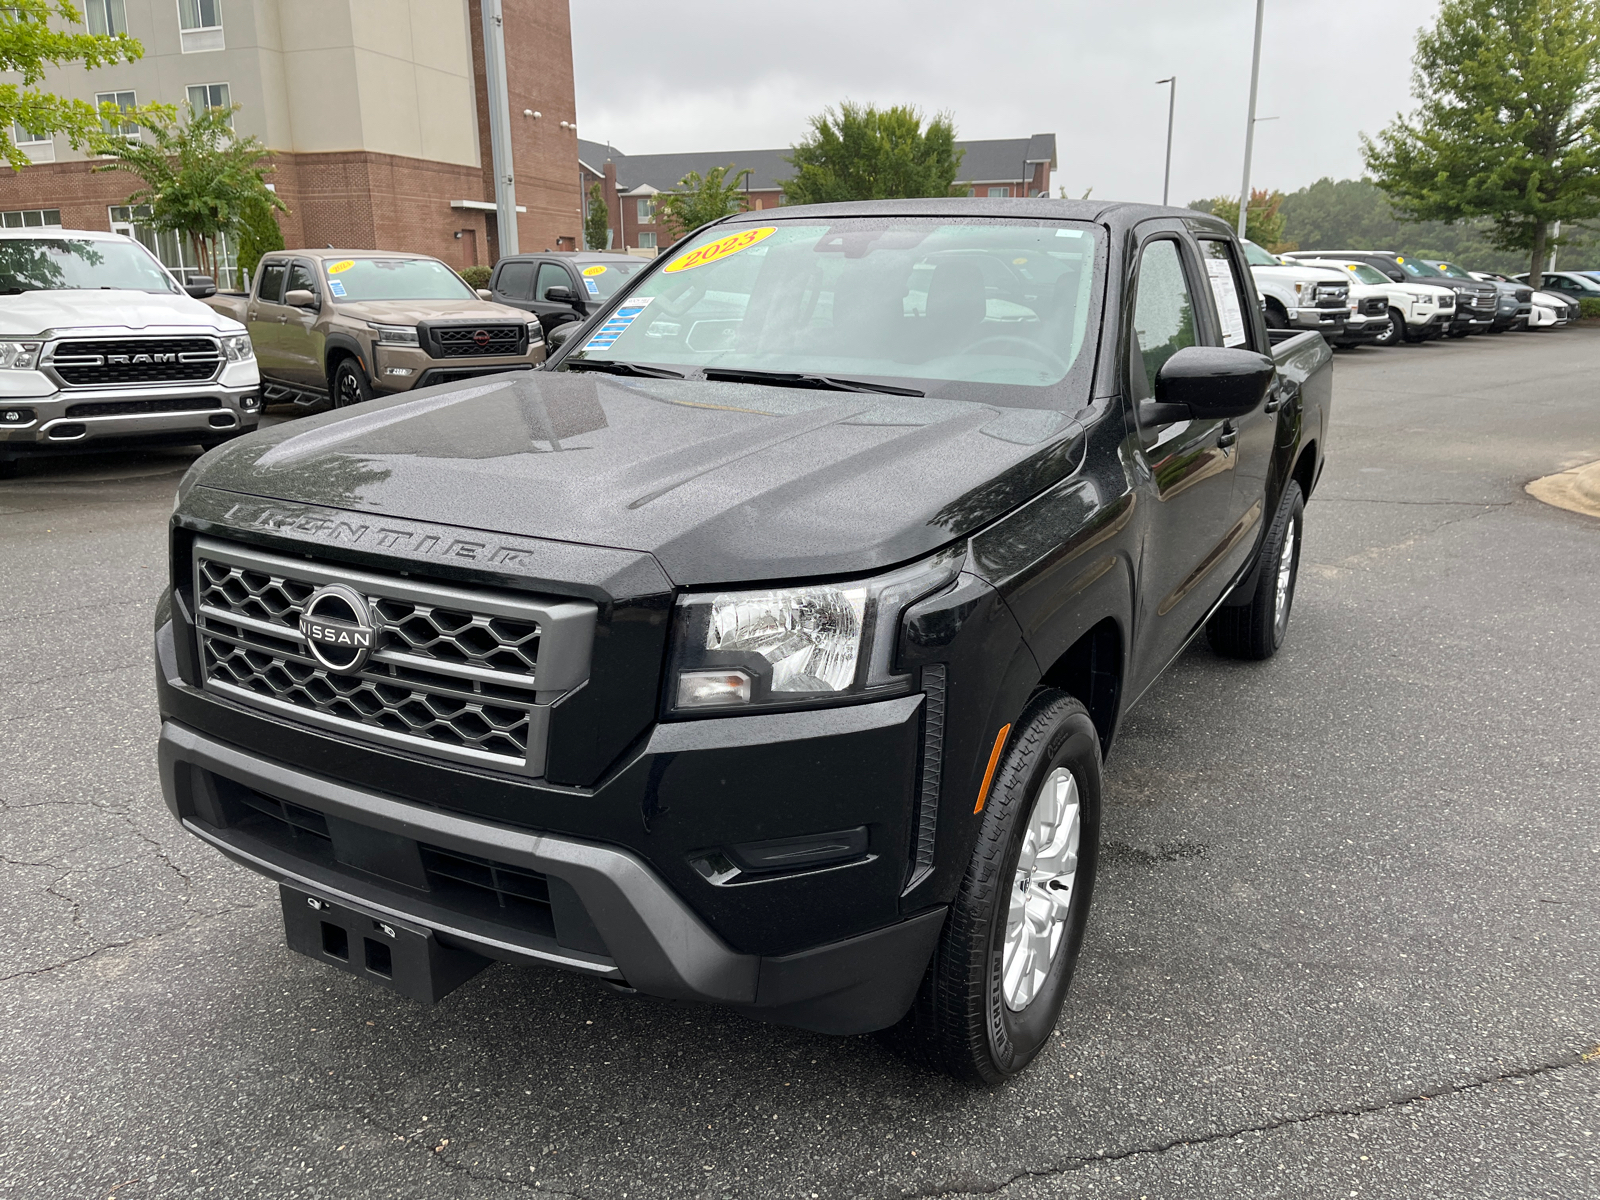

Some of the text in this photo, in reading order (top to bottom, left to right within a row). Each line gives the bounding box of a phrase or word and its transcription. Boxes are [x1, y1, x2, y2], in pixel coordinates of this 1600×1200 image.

[682, 231, 759, 269] 2023
[107, 353, 177, 364] RAM
[299, 619, 370, 646] NISSAN
[992, 956, 1007, 1048] MICHELIN
